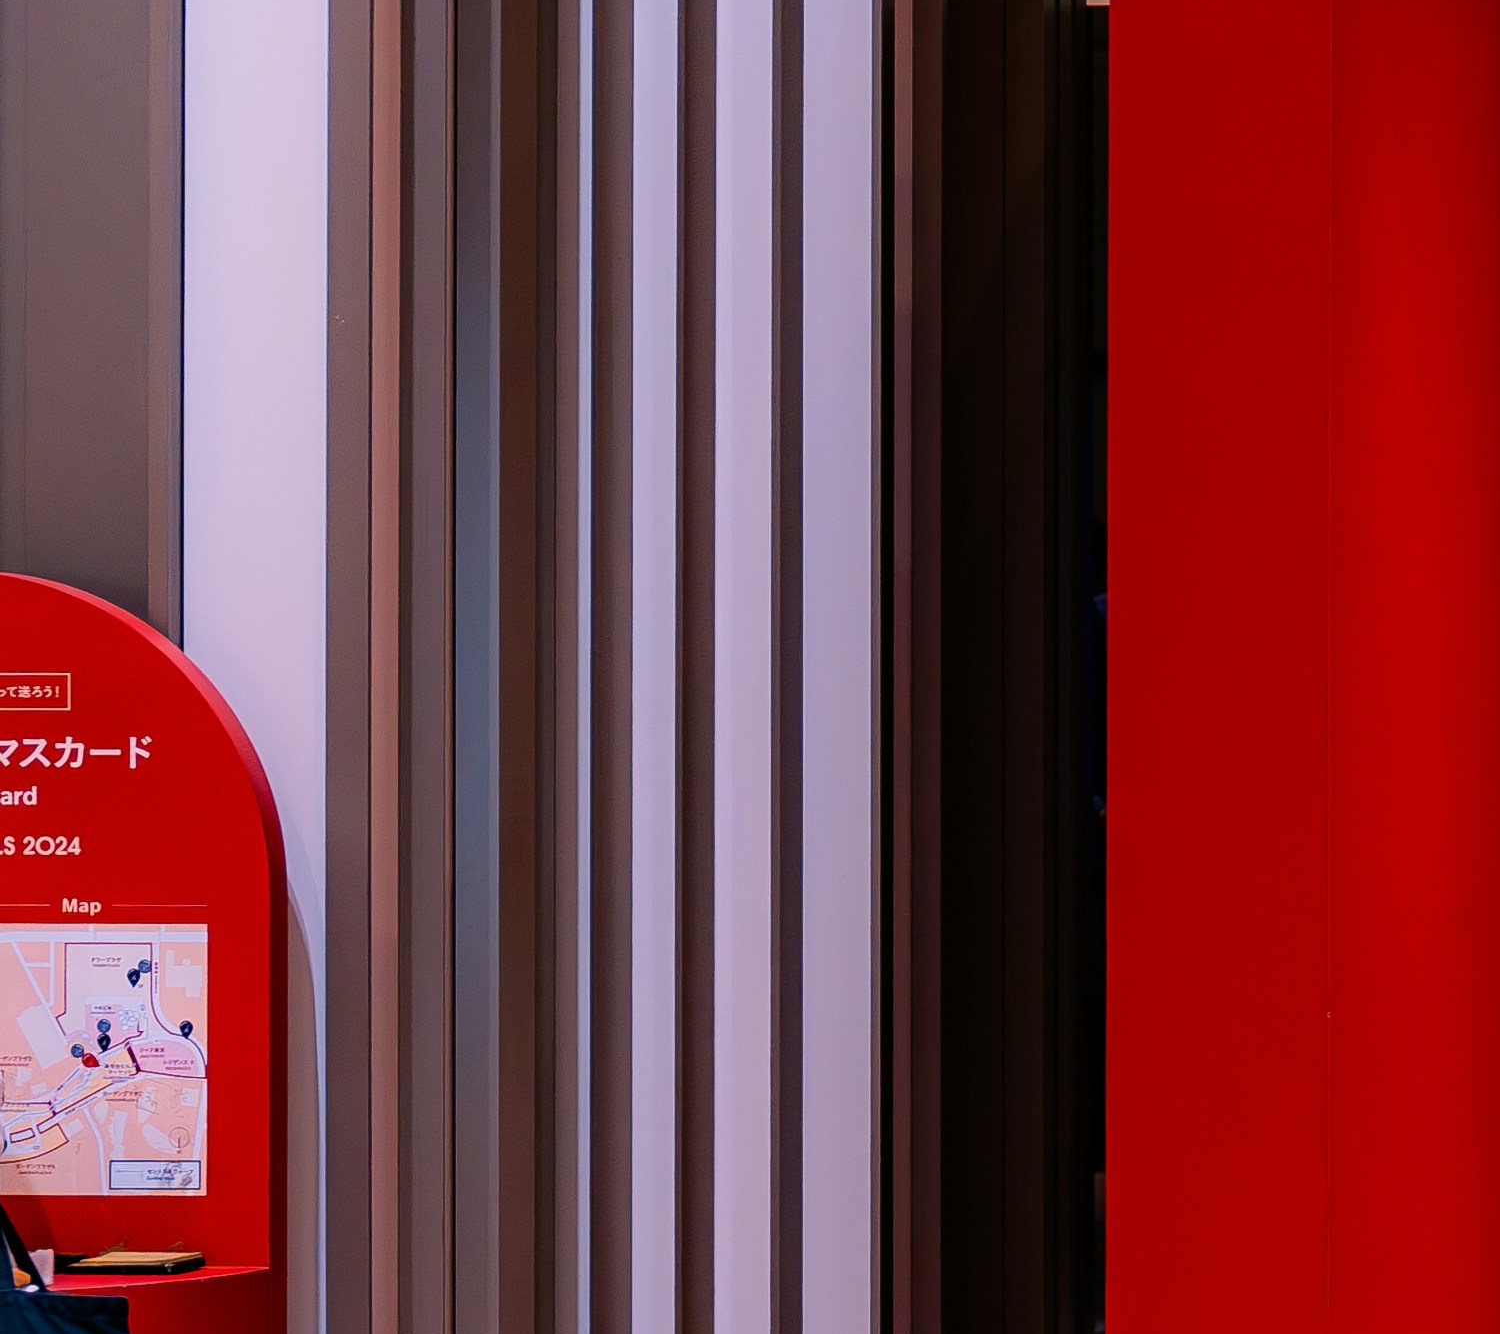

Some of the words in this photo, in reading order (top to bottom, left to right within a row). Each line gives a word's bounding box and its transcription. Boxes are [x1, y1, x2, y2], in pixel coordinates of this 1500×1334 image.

[0, 835, 16, 856] S
[22, 835, 82, 857] 2024
[61, 897, 102, 916] Map
